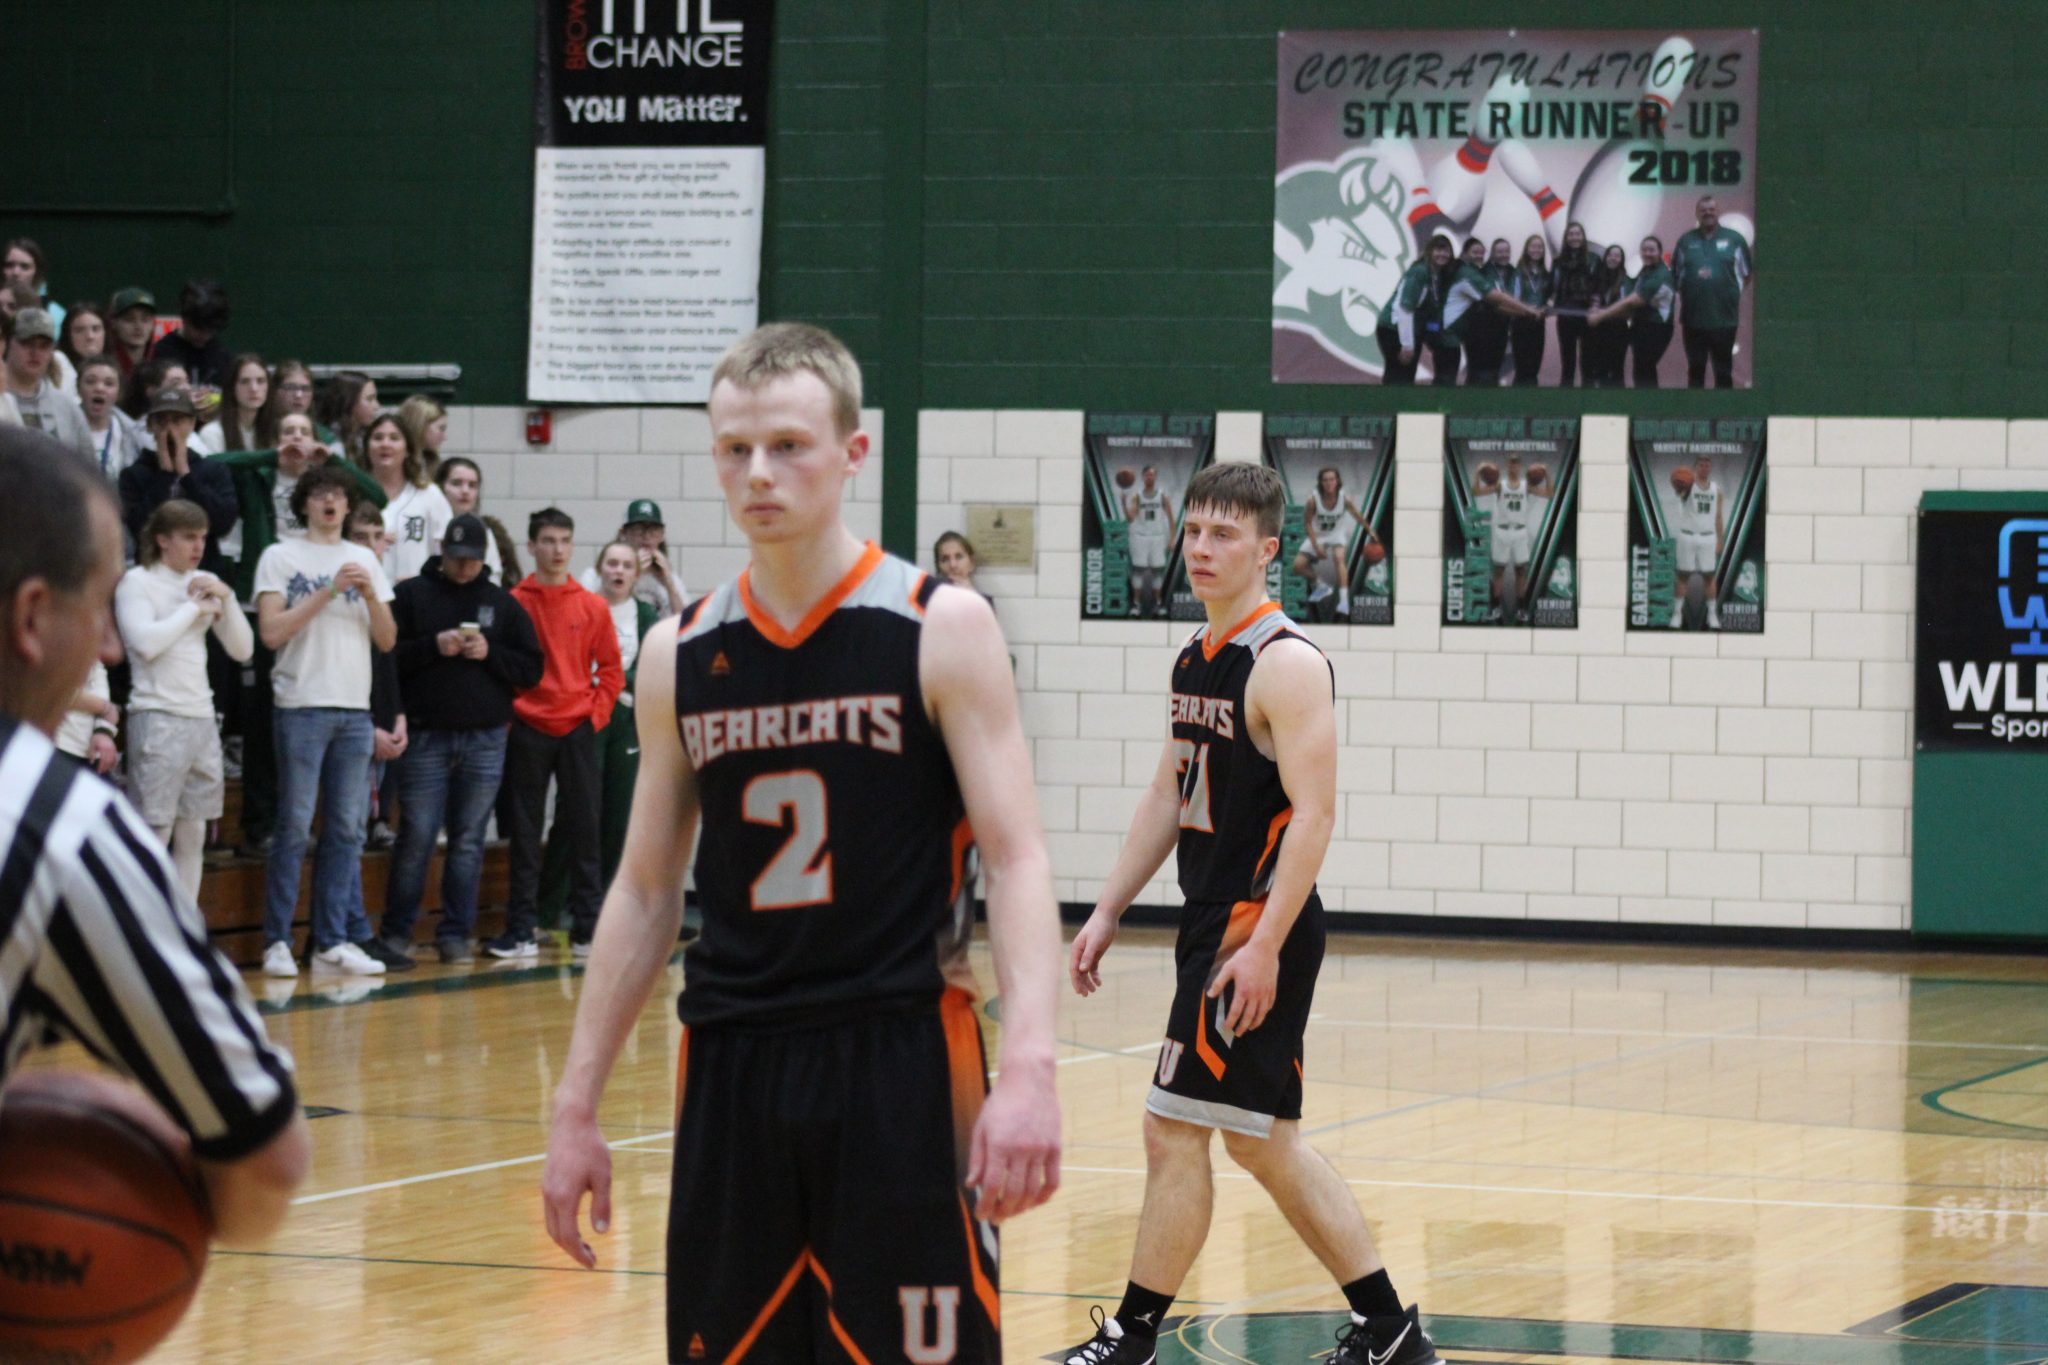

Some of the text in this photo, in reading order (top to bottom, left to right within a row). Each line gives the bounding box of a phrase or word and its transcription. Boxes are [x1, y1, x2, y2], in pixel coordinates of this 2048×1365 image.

[586, 35, 743, 69] CHANGE
[1294, 51, 1743, 98] CONGRATULATIONS
[1343, 101, 1469, 140] STATE
[1628, 149, 1742, 186] 2018
[1086, 548, 1103, 615] CONNOR
[1353, 596, 1388, 607] SENIOR
[1447, 559, 1464, 621] CURTIS
[1537, 599, 1572, 609] SENIOR
[1632, 545, 1648, 626] GARRETT
[1722, 603, 1758, 614] SENIOR
[681, 694, 903, 771] BEARCATS
[741, 768, 833, 911] 2
[1154, 1037, 1184, 1087] U
[898, 1285, 960, 1364] U
